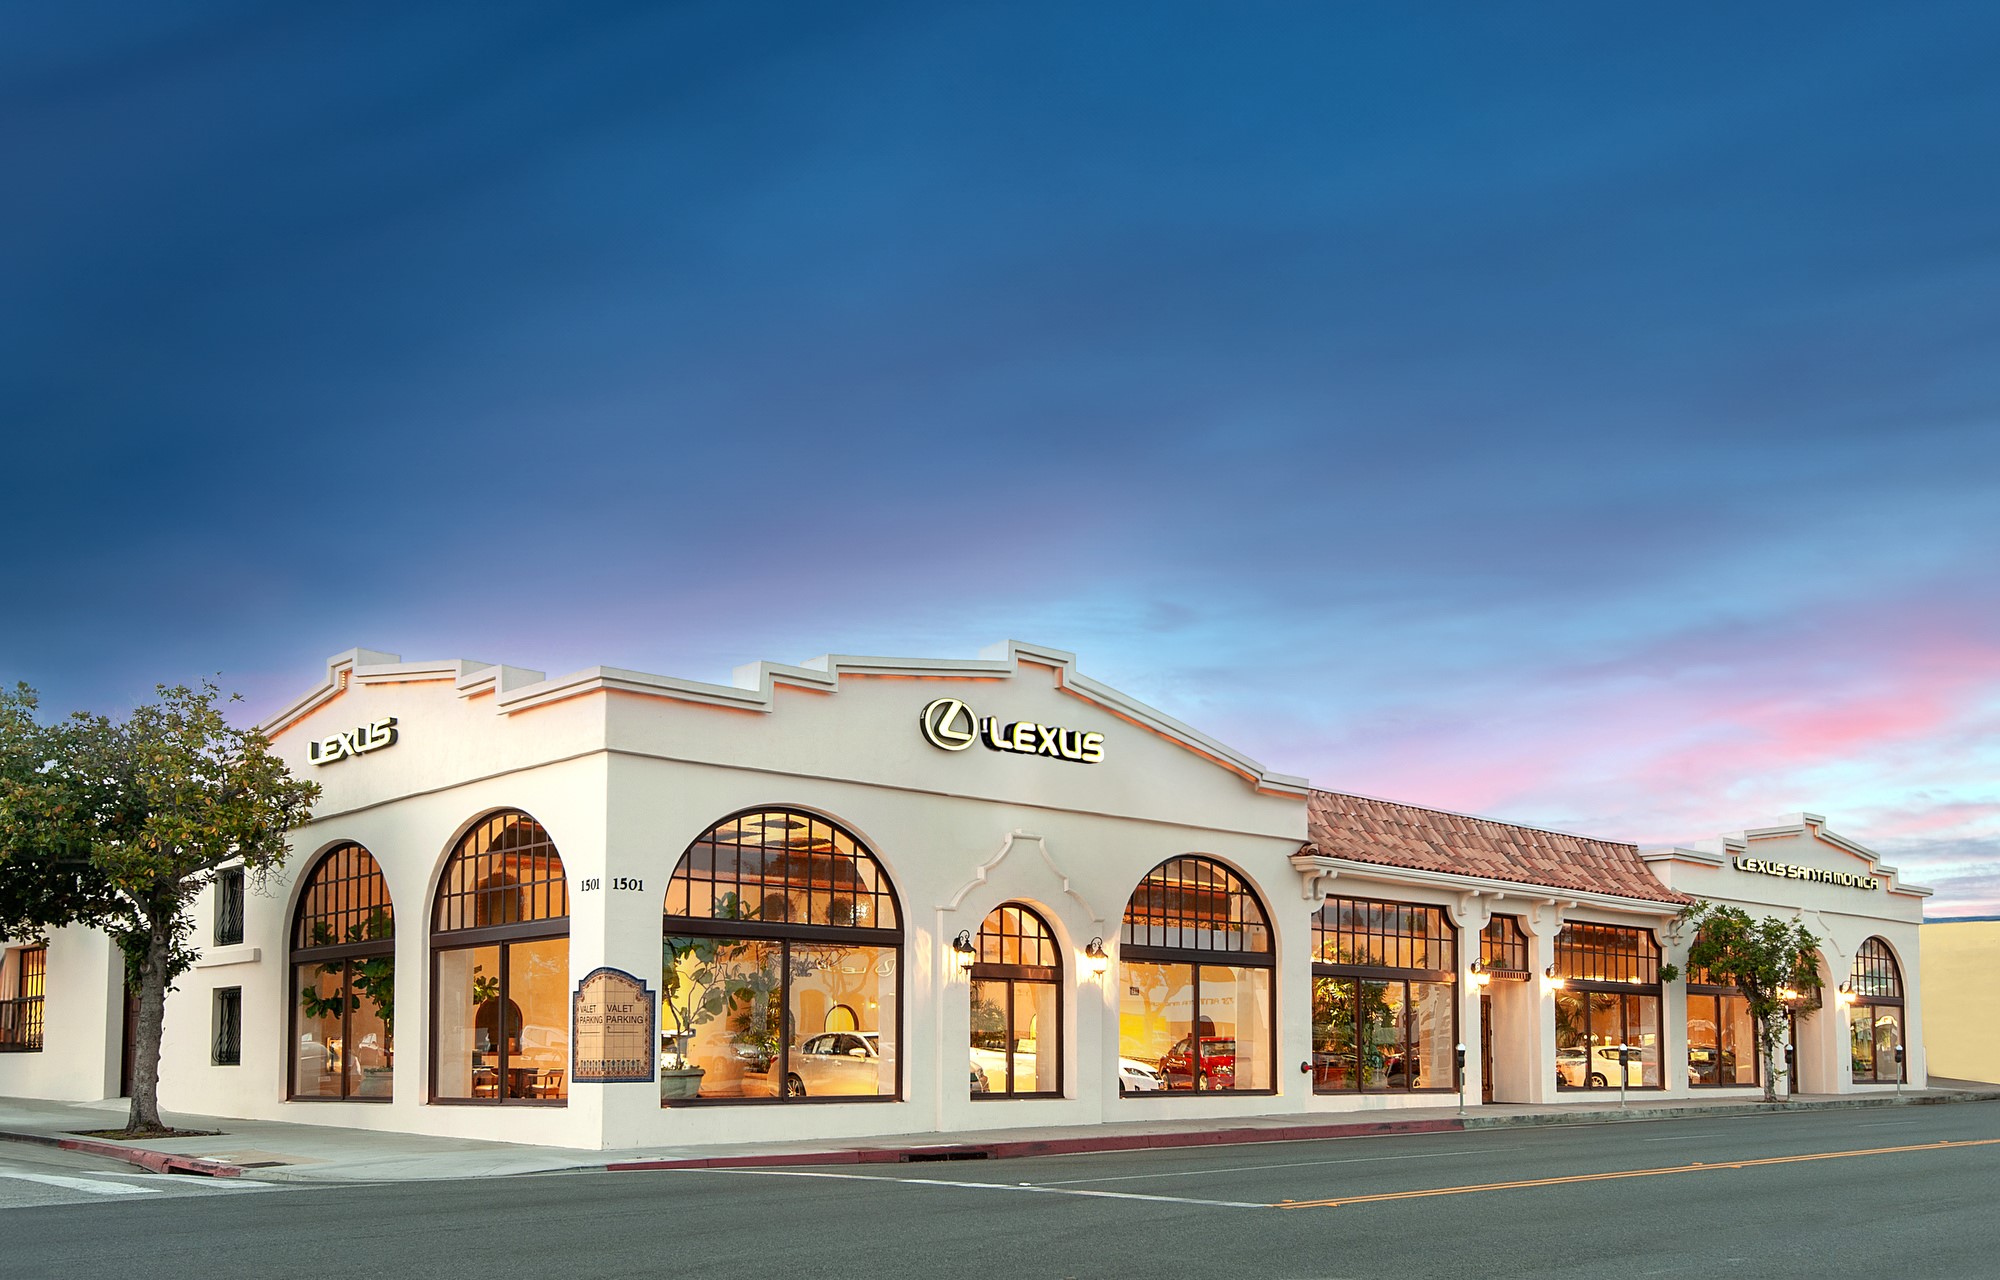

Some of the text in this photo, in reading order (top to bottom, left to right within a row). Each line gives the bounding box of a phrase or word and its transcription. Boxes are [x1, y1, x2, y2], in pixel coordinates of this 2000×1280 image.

[307, 716, 397, 766] LEXUS
[984, 715, 1105, 763] LEXUS
[1734, 856, 1880, 890] LEXUS SANTA MONICA
[581, 878, 600, 892] 1501
[613, 877, 644, 892] 1501
[580, 1005, 596, 1013] VALET
[606, 1004, 634, 1013] VALET
[579, 1015, 604, 1024] PARKING
[605, 1015, 644, 1024] PARKING
